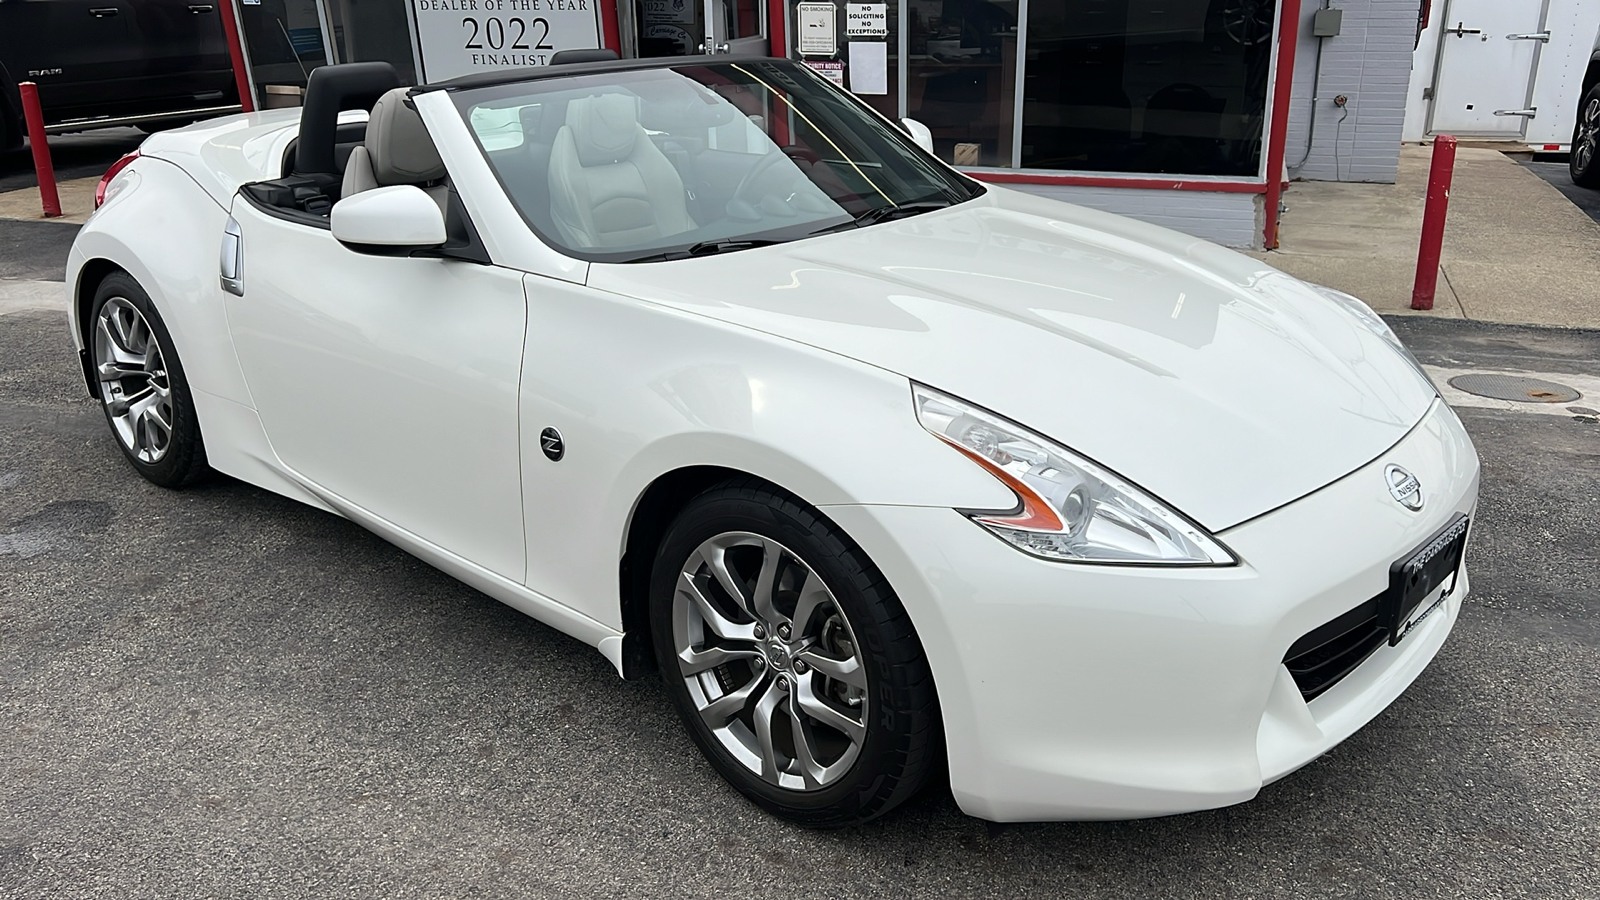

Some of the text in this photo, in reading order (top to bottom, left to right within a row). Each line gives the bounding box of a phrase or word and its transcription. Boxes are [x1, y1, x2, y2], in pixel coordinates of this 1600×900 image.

[420, 0, 588, 11] DEALER OF THE YEAR
[462, 17, 554, 50] 2022
[472, 53, 547, 66] FINALIST
[28, 67, 62, 76] RAM
[825, 62, 842, 70] NOTICE
[1397, 478, 1418, 496] NISS
